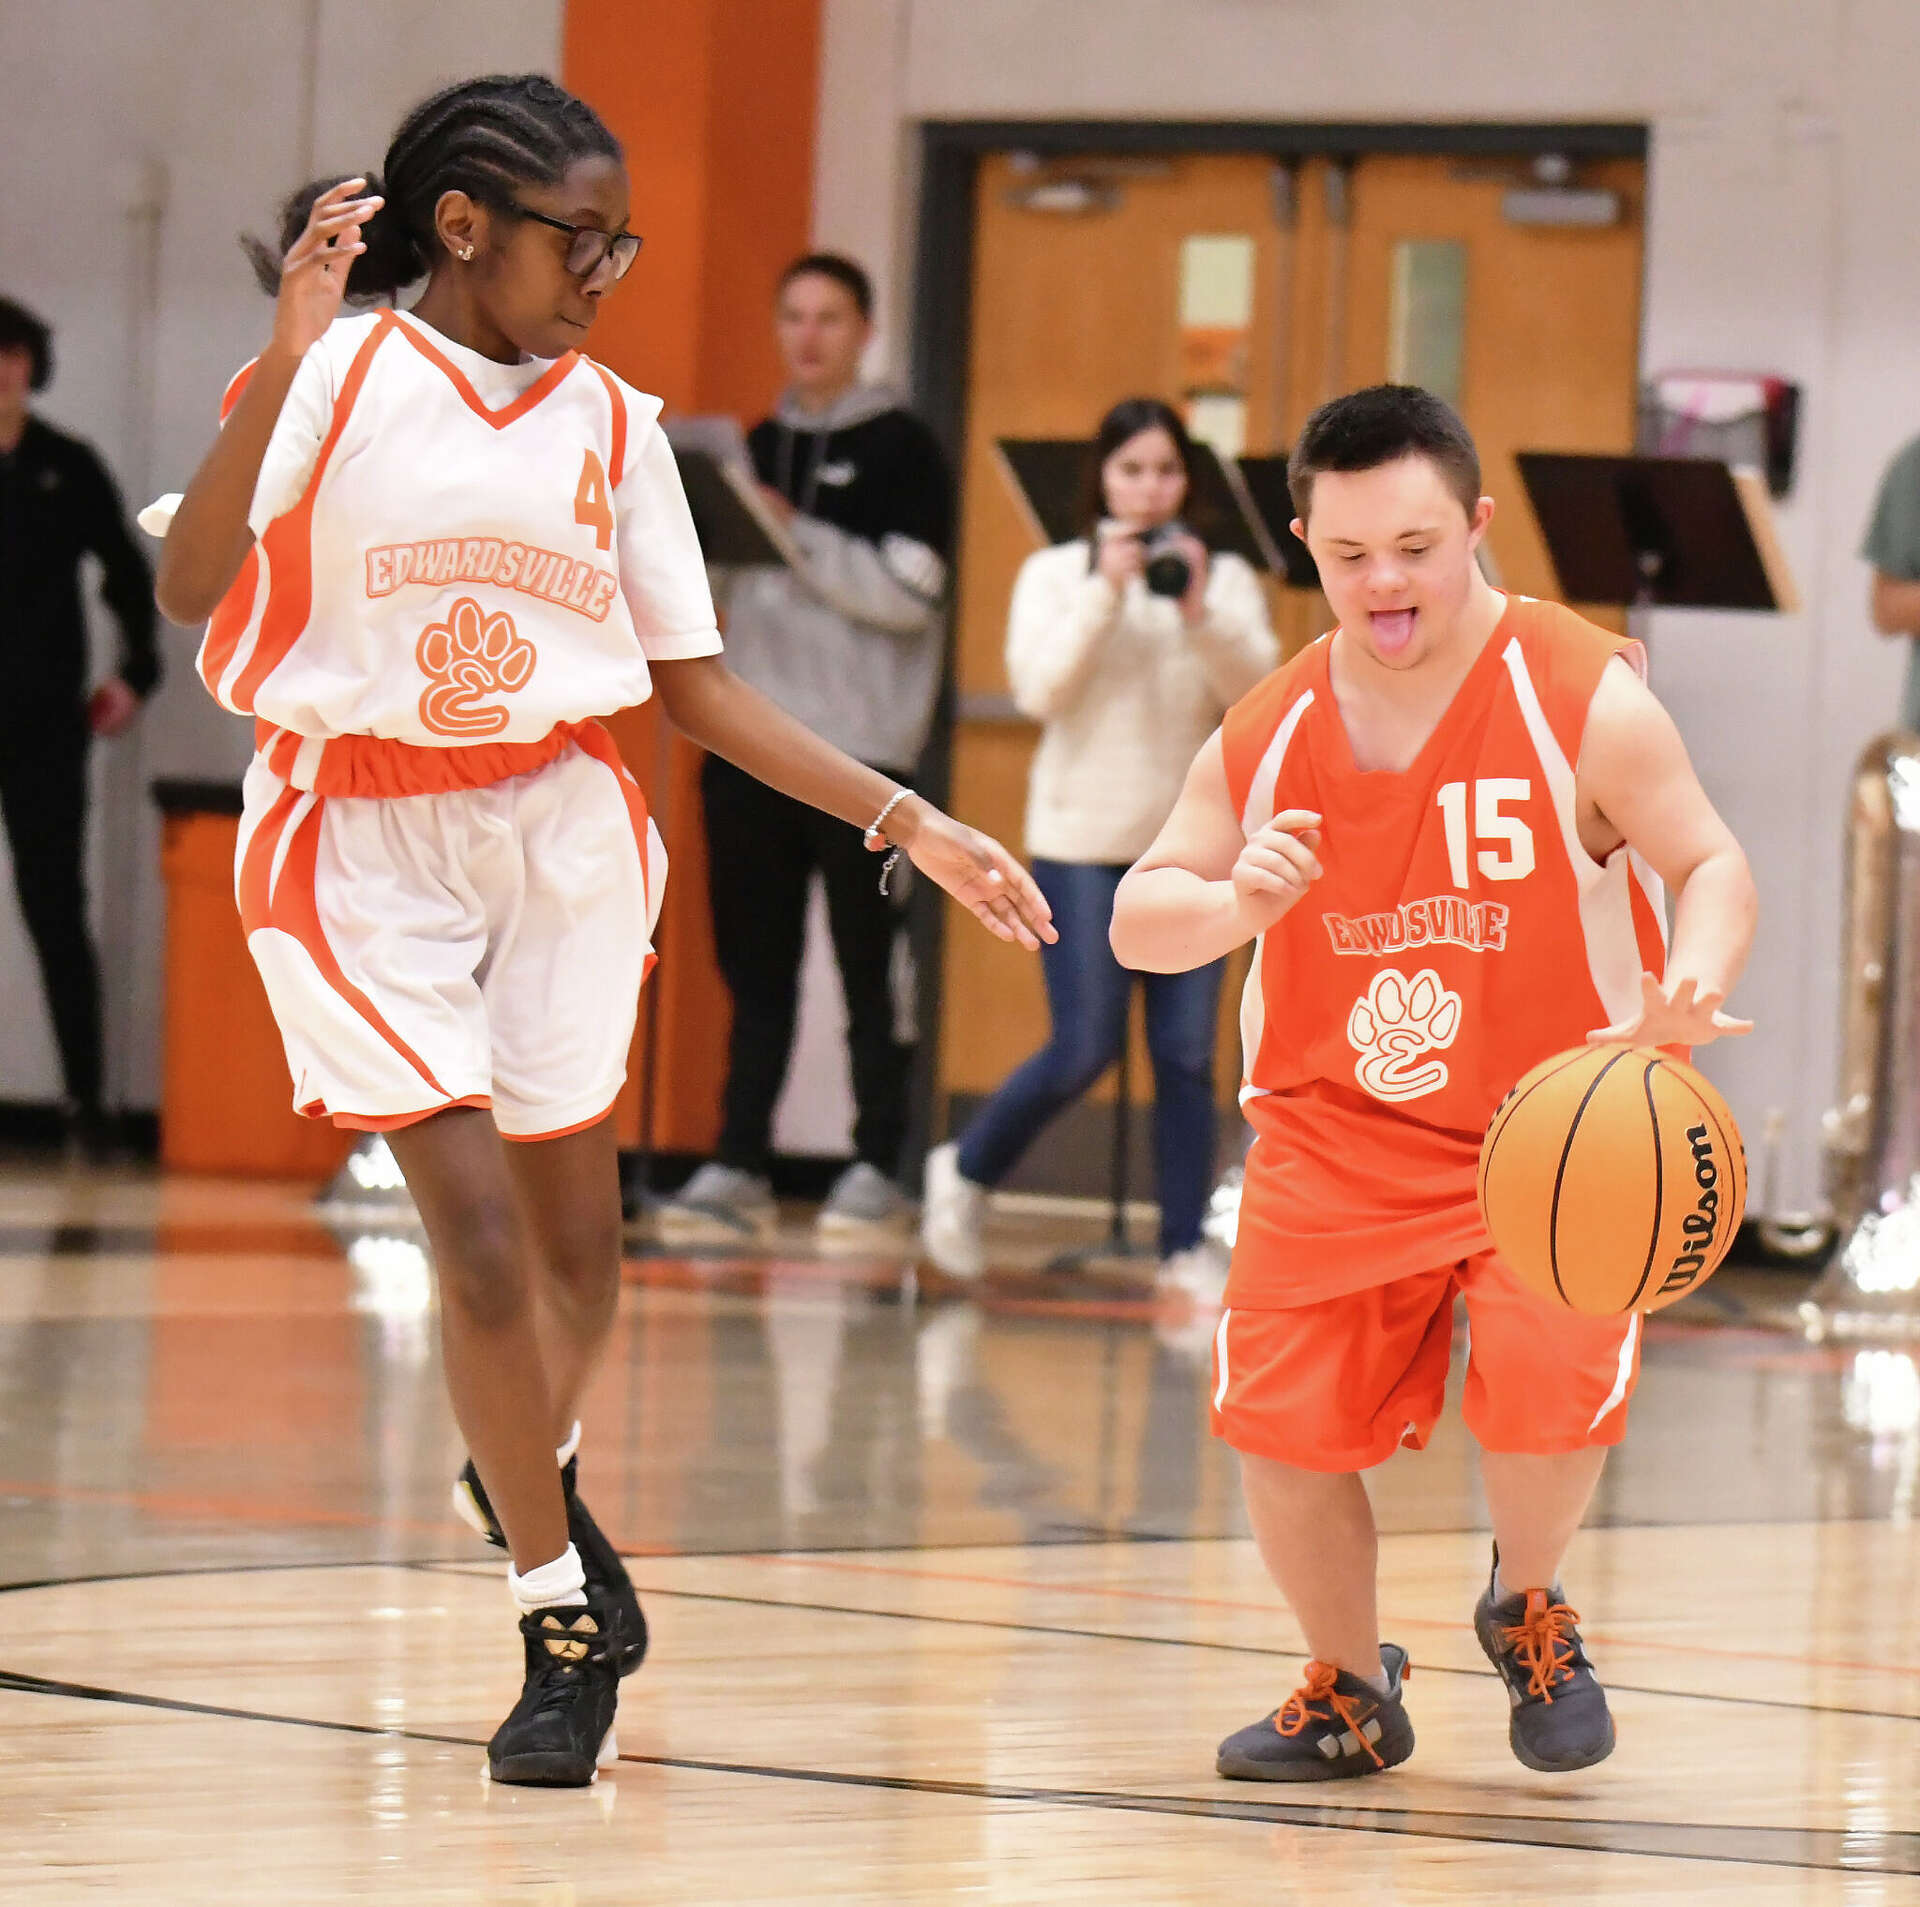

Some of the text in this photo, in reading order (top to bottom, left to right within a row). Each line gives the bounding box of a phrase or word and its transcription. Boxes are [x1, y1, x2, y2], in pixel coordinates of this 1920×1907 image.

[573, 448, 614, 551] 4
[365, 537, 618, 623] EDWARDSVILLE
[1437, 777, 1536, 890] 15
[1655, 1122, 1719, 1297] Wilson
